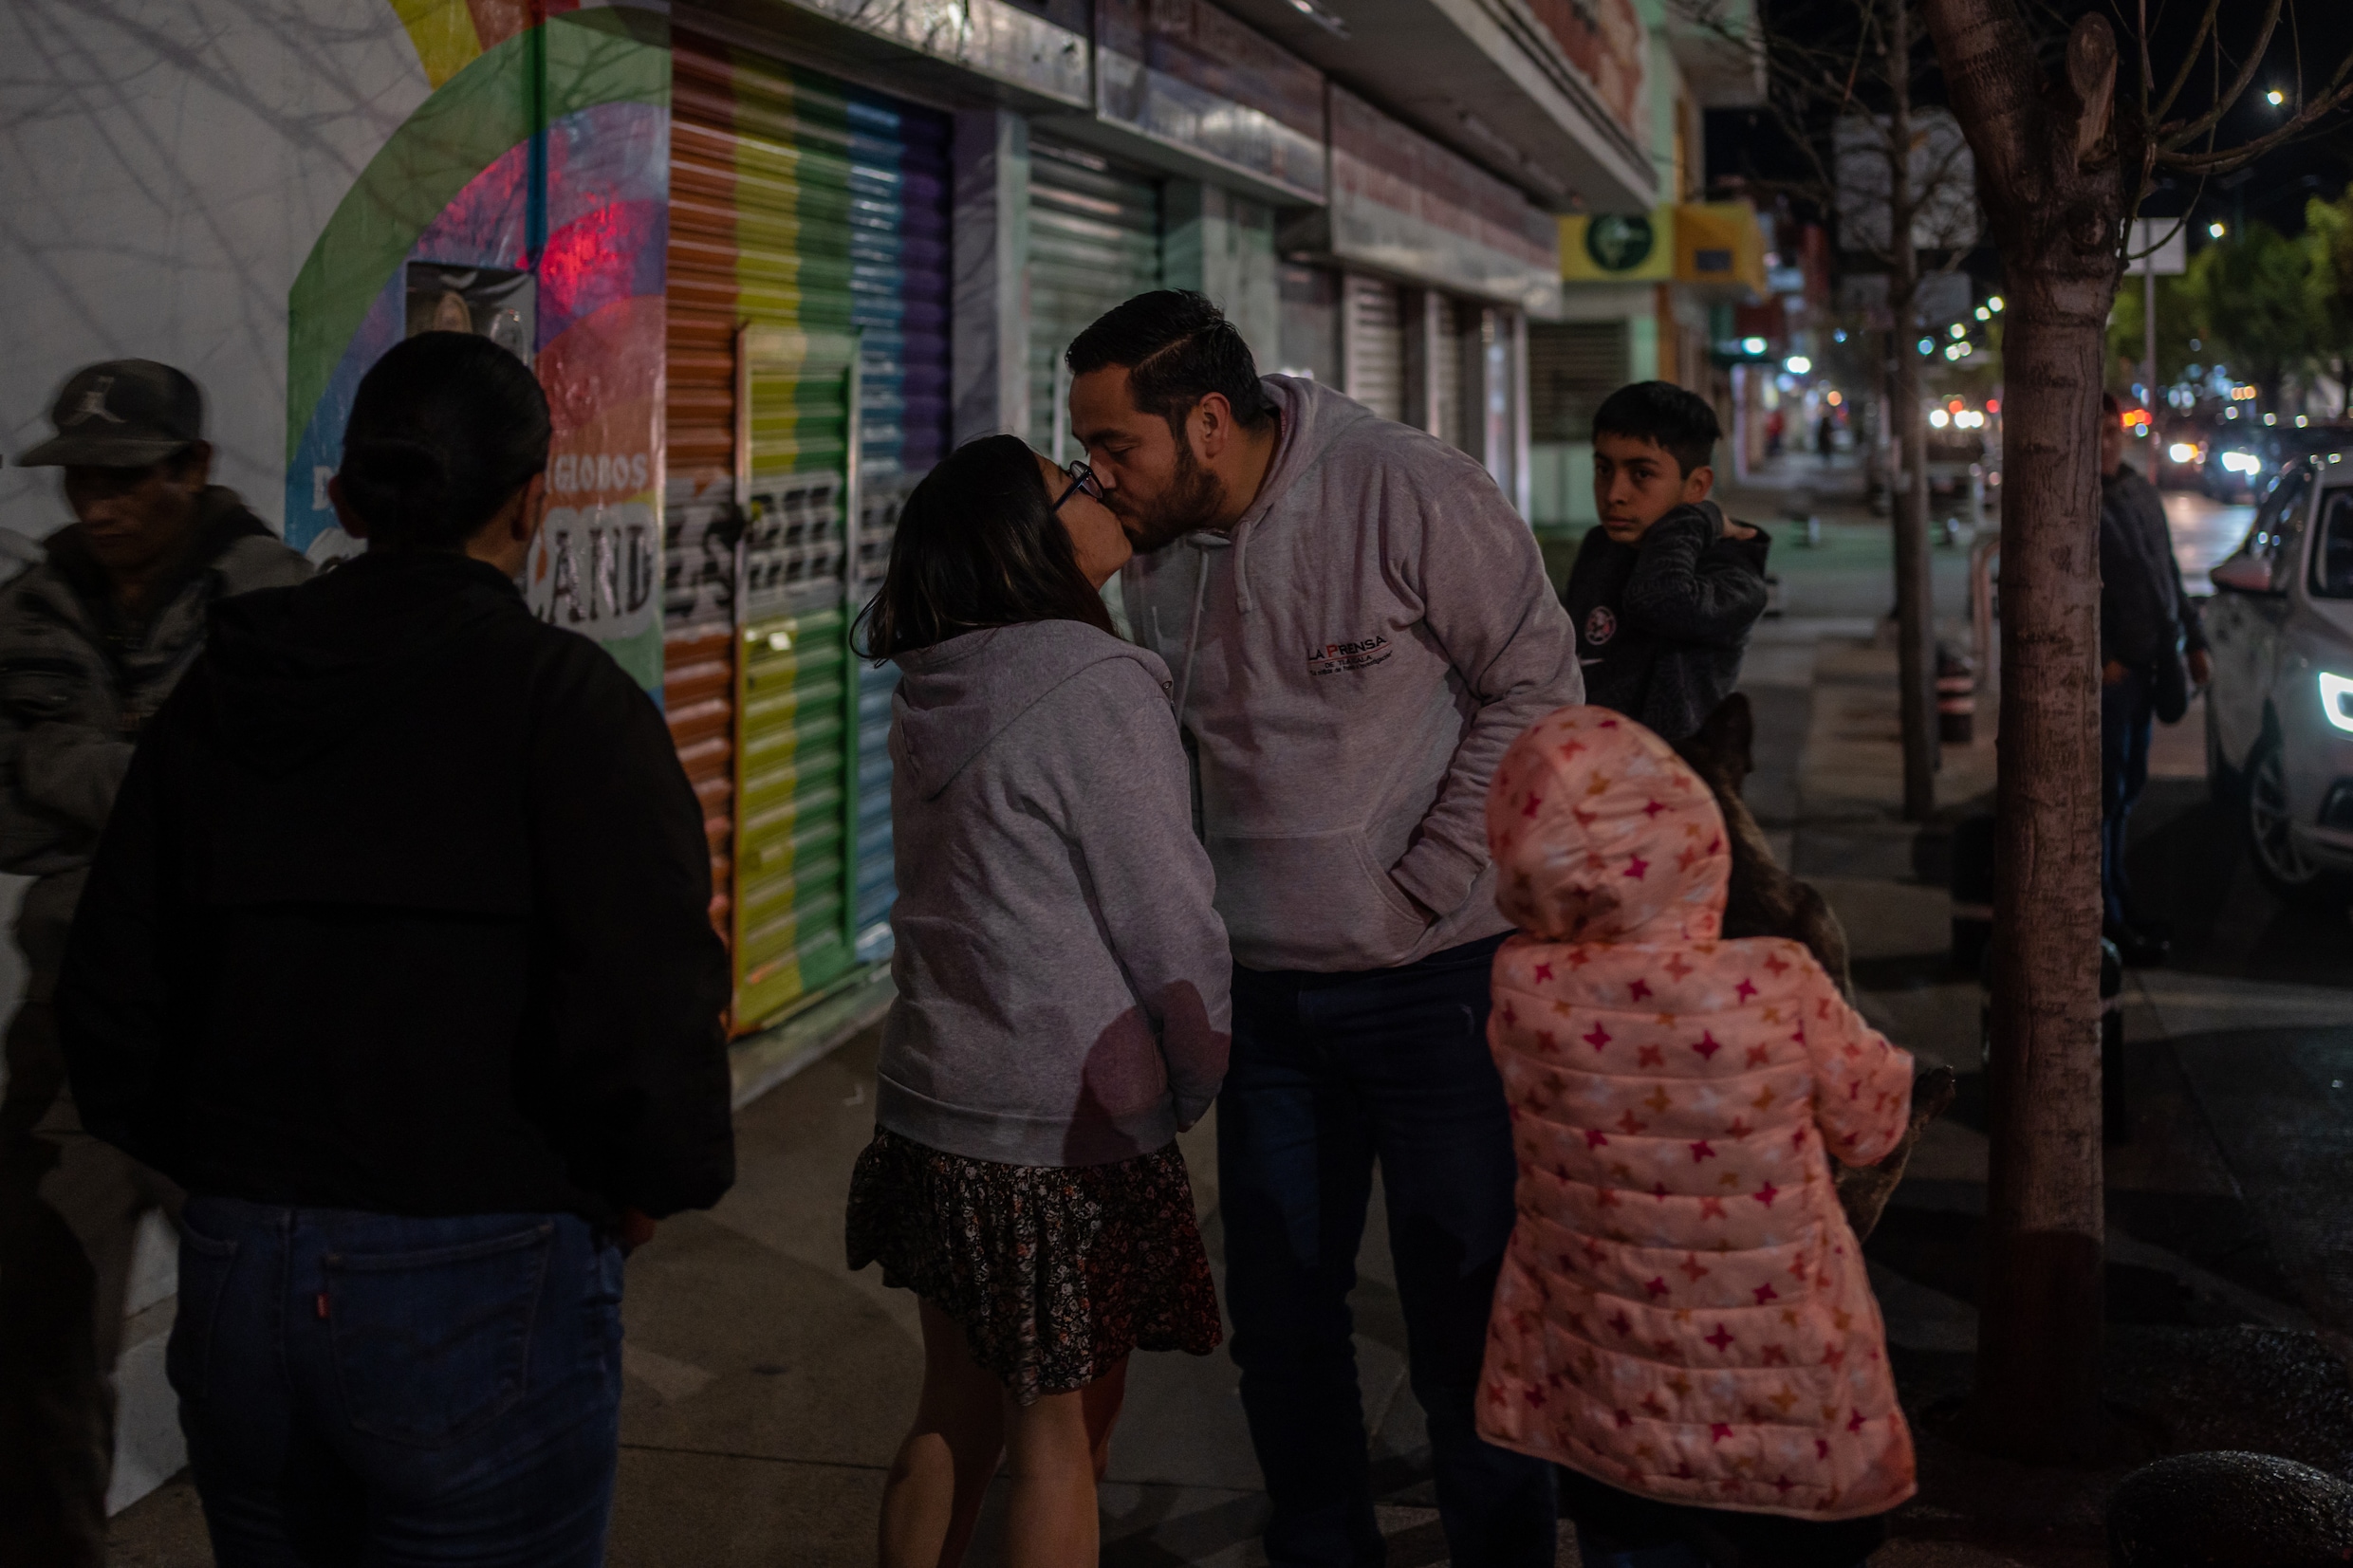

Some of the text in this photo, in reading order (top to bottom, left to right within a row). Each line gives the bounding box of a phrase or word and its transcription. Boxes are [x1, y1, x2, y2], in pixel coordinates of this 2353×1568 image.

[553, 452, 649, 493] GLOBOS
[1307, 636, 1387, 661] LA PRENSA
